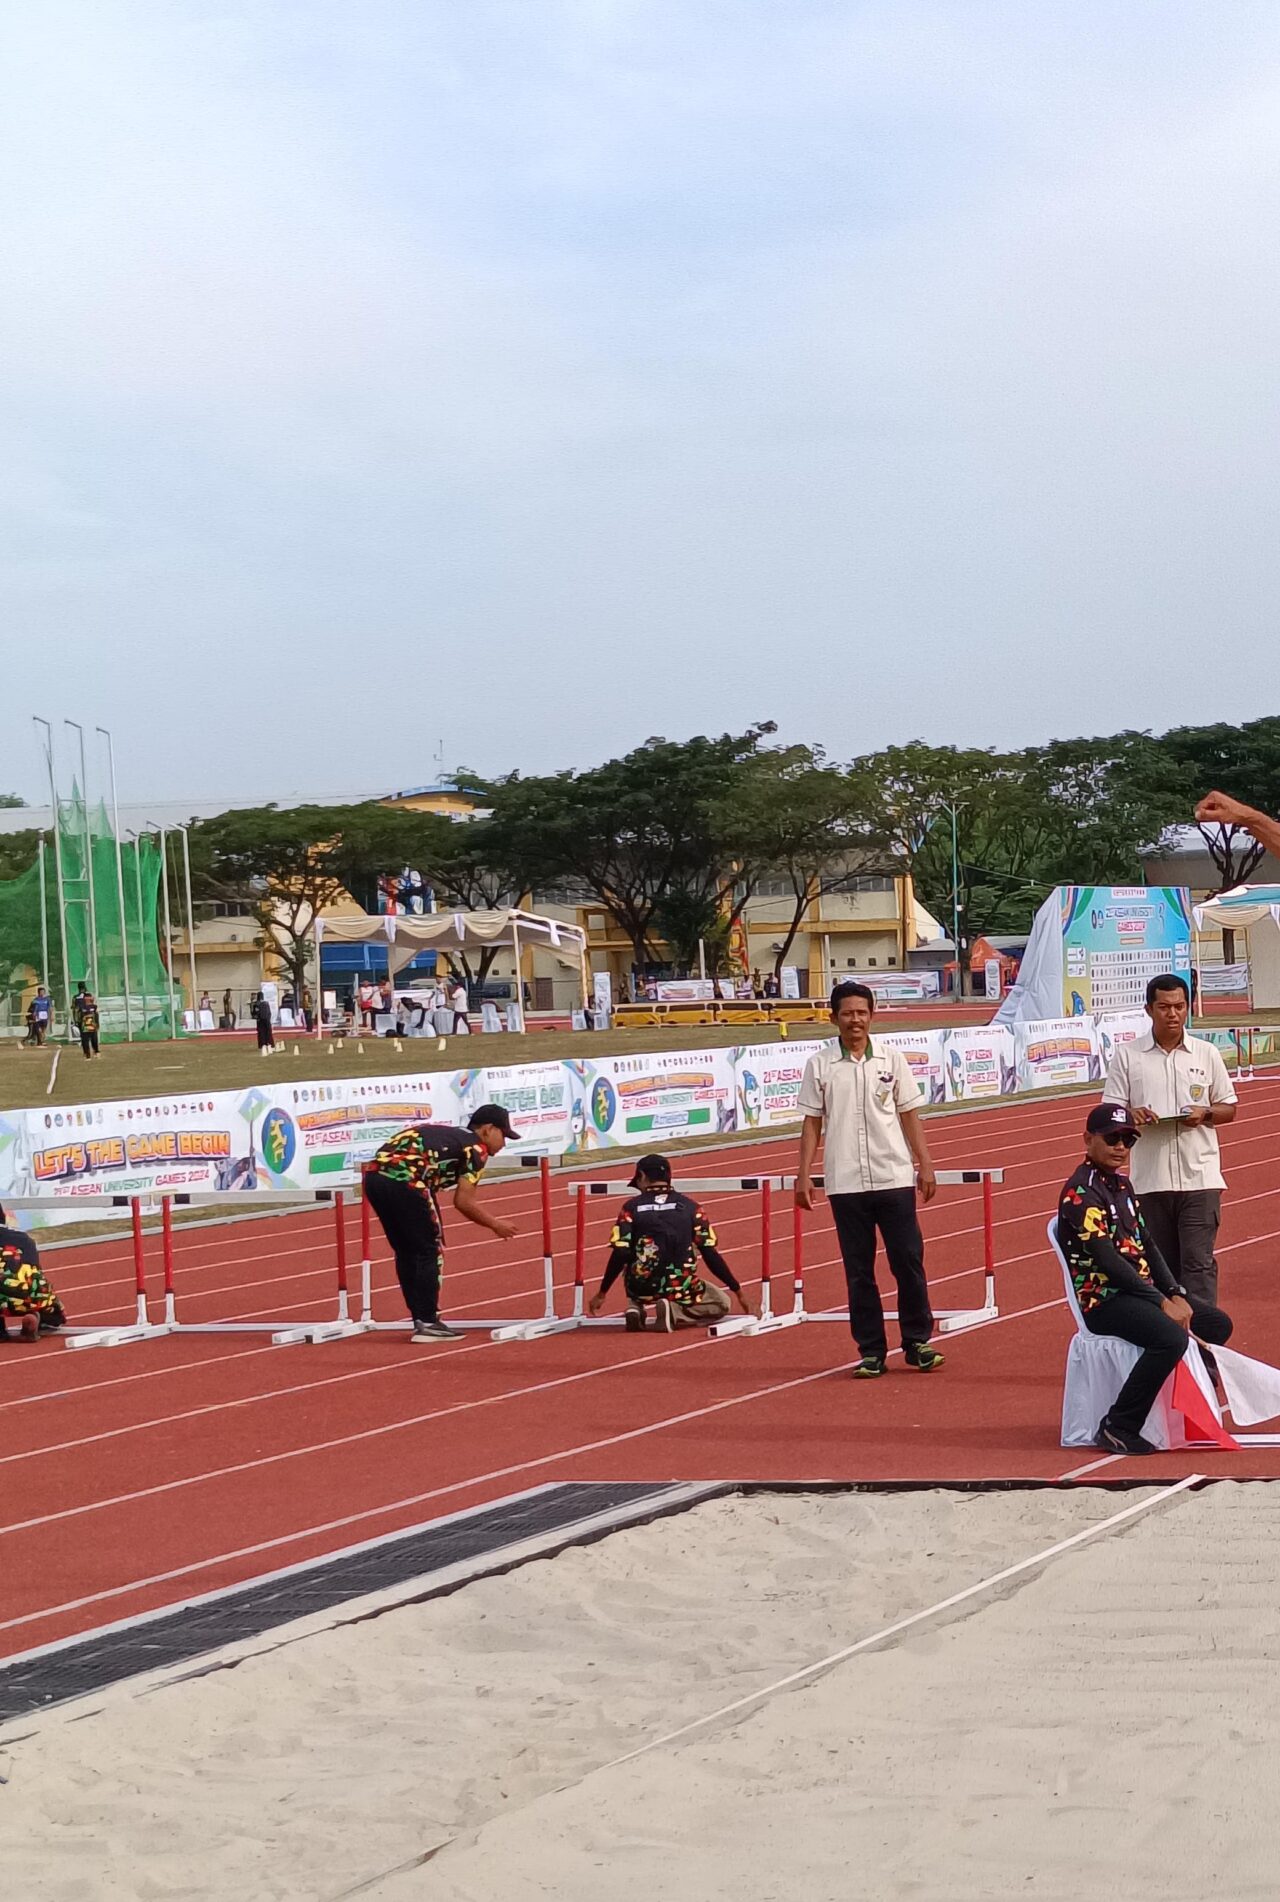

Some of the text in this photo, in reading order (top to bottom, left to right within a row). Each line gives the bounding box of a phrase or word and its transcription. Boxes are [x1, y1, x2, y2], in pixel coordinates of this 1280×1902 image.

[34, 1131, 230, 1181] LET'S THE GAME BEGIN
[155, 1172, 187, 1187] GAMES
